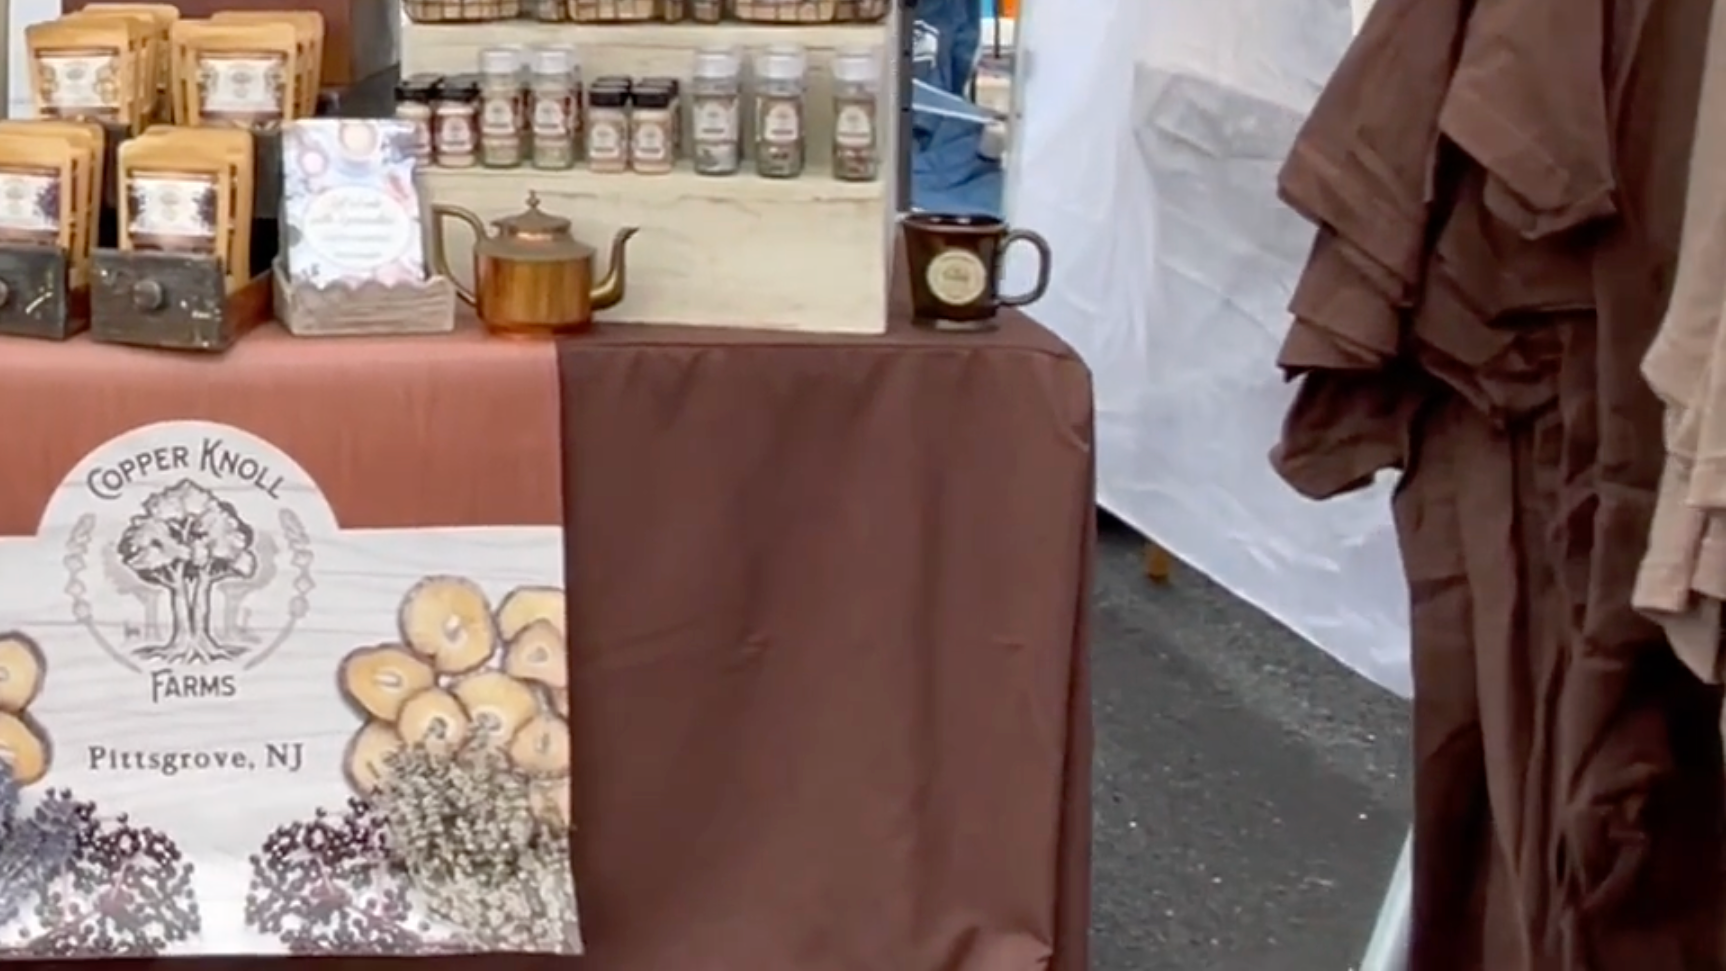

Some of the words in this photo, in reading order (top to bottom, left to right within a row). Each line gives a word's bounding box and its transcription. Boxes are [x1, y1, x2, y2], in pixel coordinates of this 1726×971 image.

[151, 669, 237, 704] FARMS
[88, 745, 256, 775] Pittsgrove,
[265, 742, 305, 773] NJ
